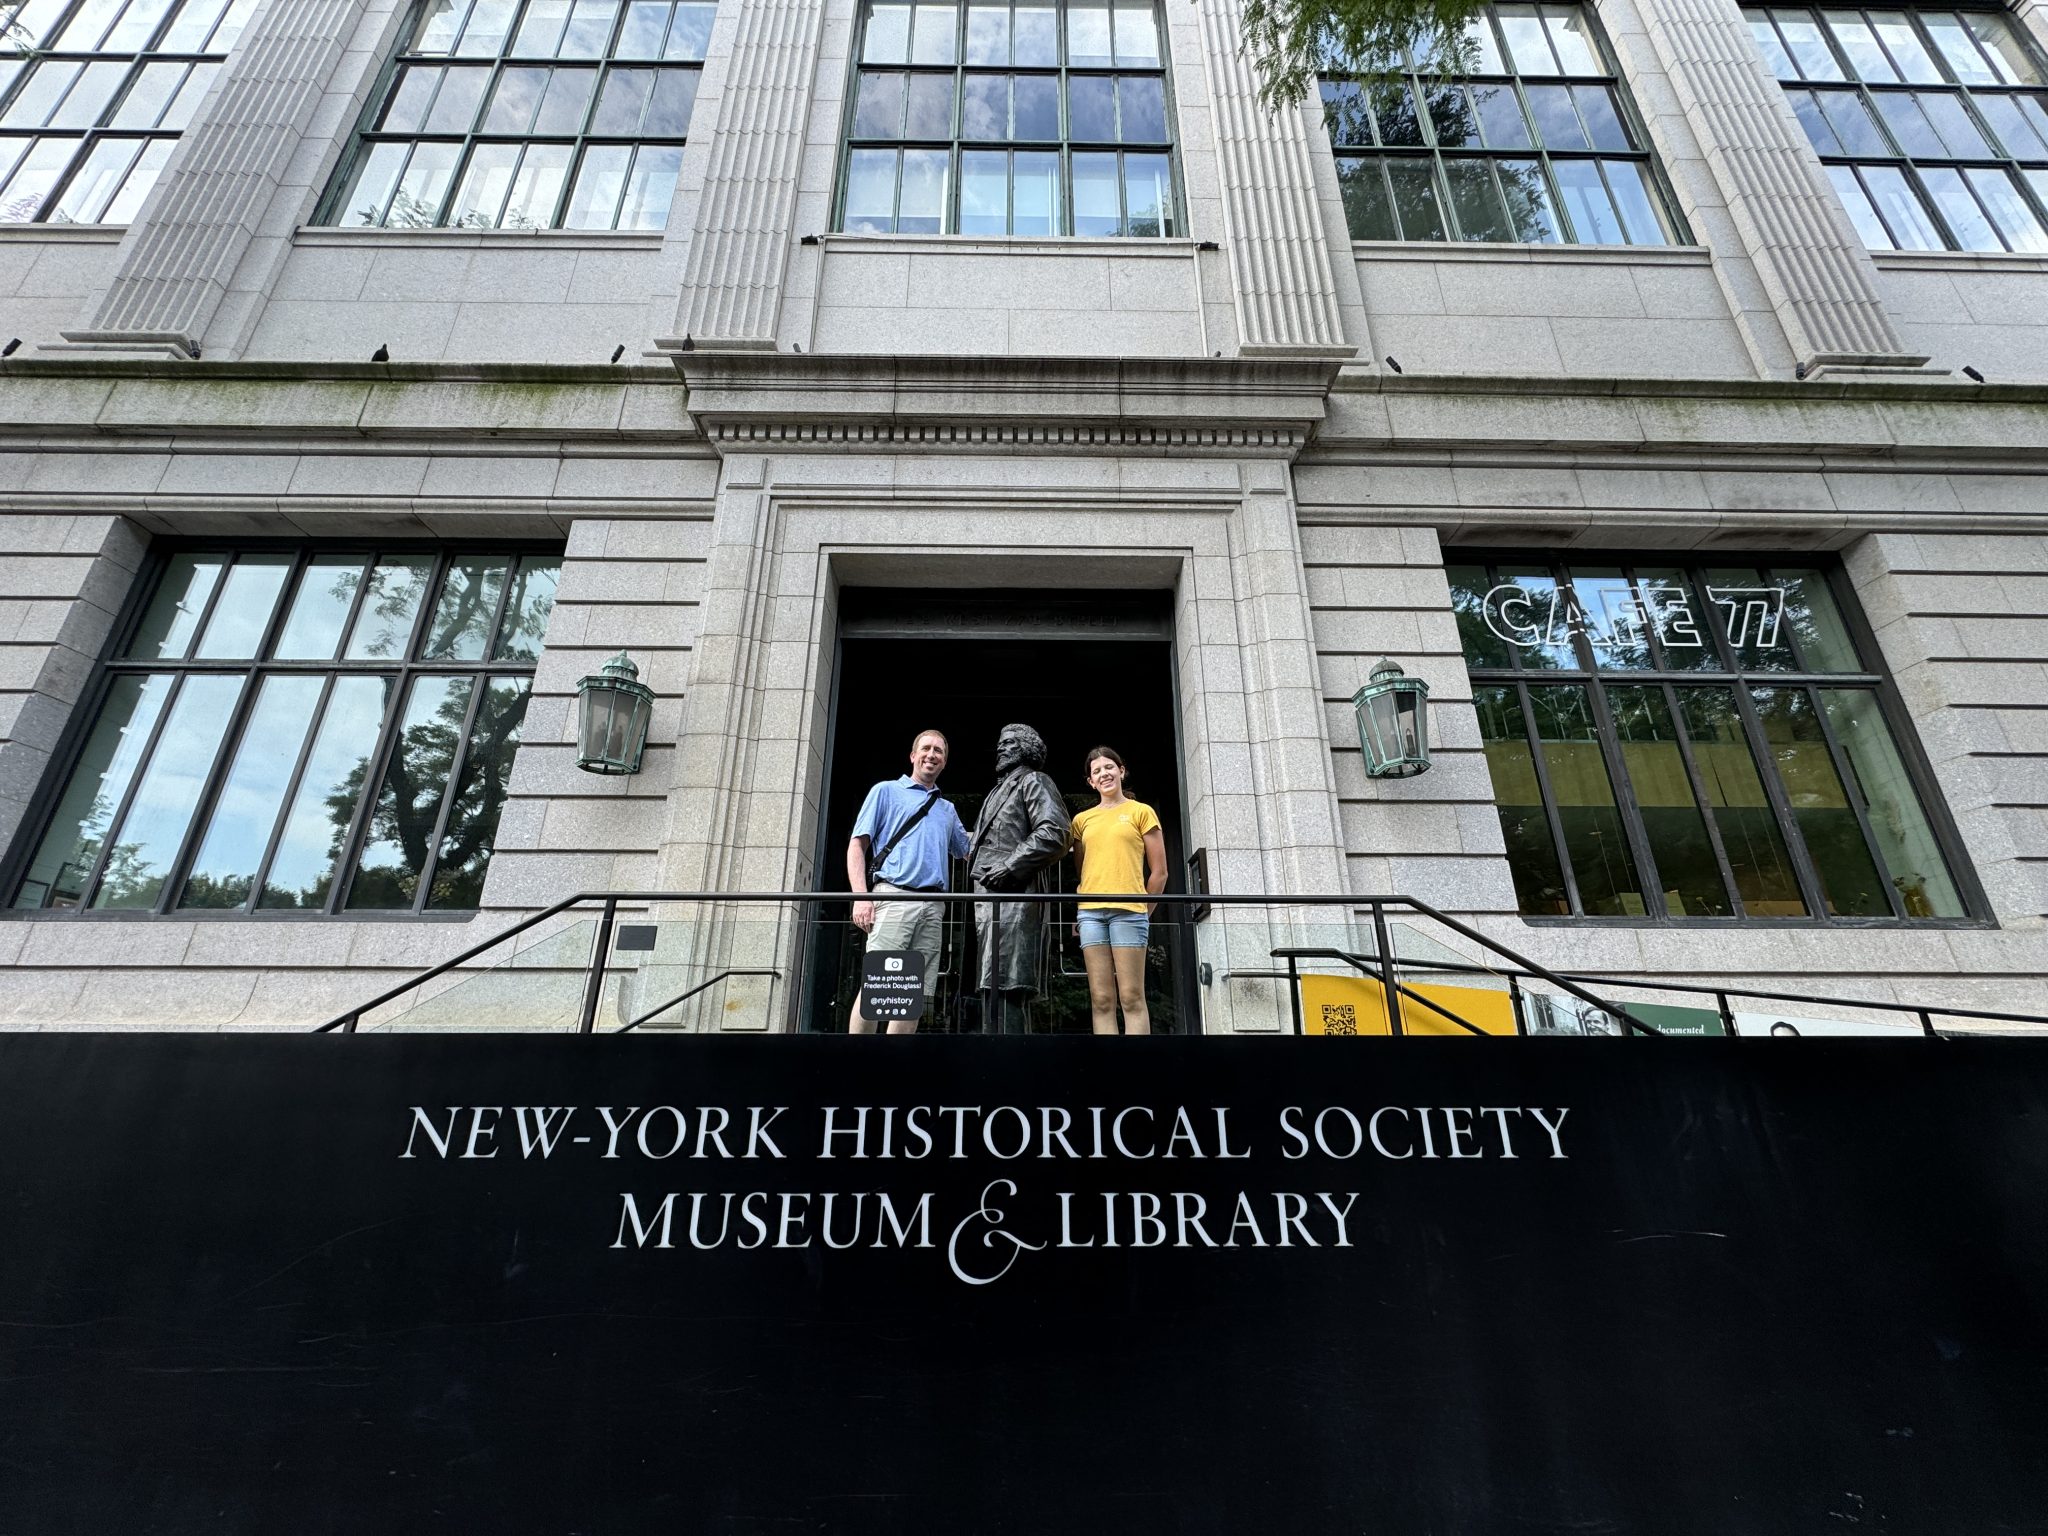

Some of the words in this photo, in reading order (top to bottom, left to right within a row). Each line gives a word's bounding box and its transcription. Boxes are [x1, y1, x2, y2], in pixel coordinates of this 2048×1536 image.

[1482, 584, 1703, 647] CAFE
[1704, 584, 1785, 648] 77
[863, 982, 892, 990] Frederick
[892, 982, 922, 991] Douglass!
[867, 974, 881, 982] Take
[886, 974, 904, 983] photo
[904, 974, 919, 982] with
[870, 996, 914, 1006] @nyhistory
[398, 1106, 789, 1159] NEW-YORK
[816, 1105, 1251, 1159] HISTORICAL
[1279, 1106, 1570, 1159] SOCIETY
[609, 1191, 936, 1250] MUSEUM
[948, 1178, 1048, 1285] &
[1056, 1190, 1360, 1248] LIBRARY
